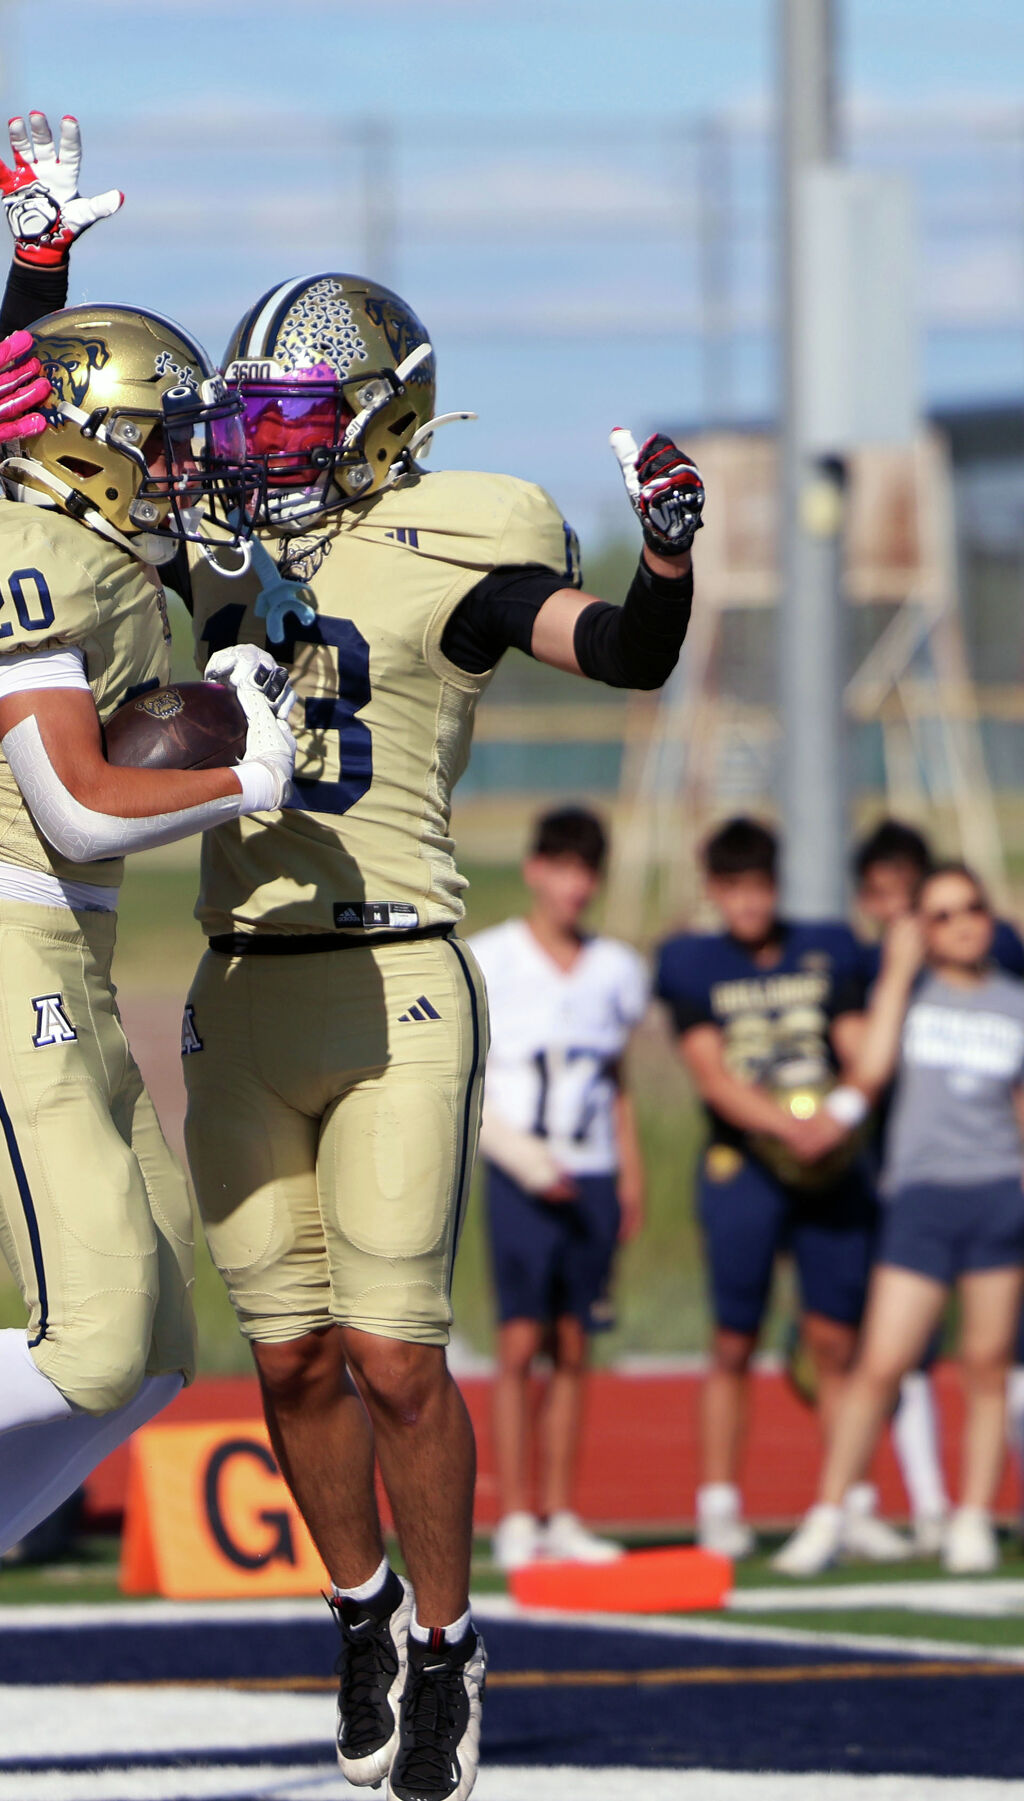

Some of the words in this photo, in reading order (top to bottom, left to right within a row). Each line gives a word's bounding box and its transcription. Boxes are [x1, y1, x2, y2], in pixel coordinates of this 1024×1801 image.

[232, 363, 270, 380] 3600
[201, 603, 373, 815] 3
[373, 911, 382, 921] M
[31, 990, 78, 1048] A
[203, 1437, 297, 1572] G
